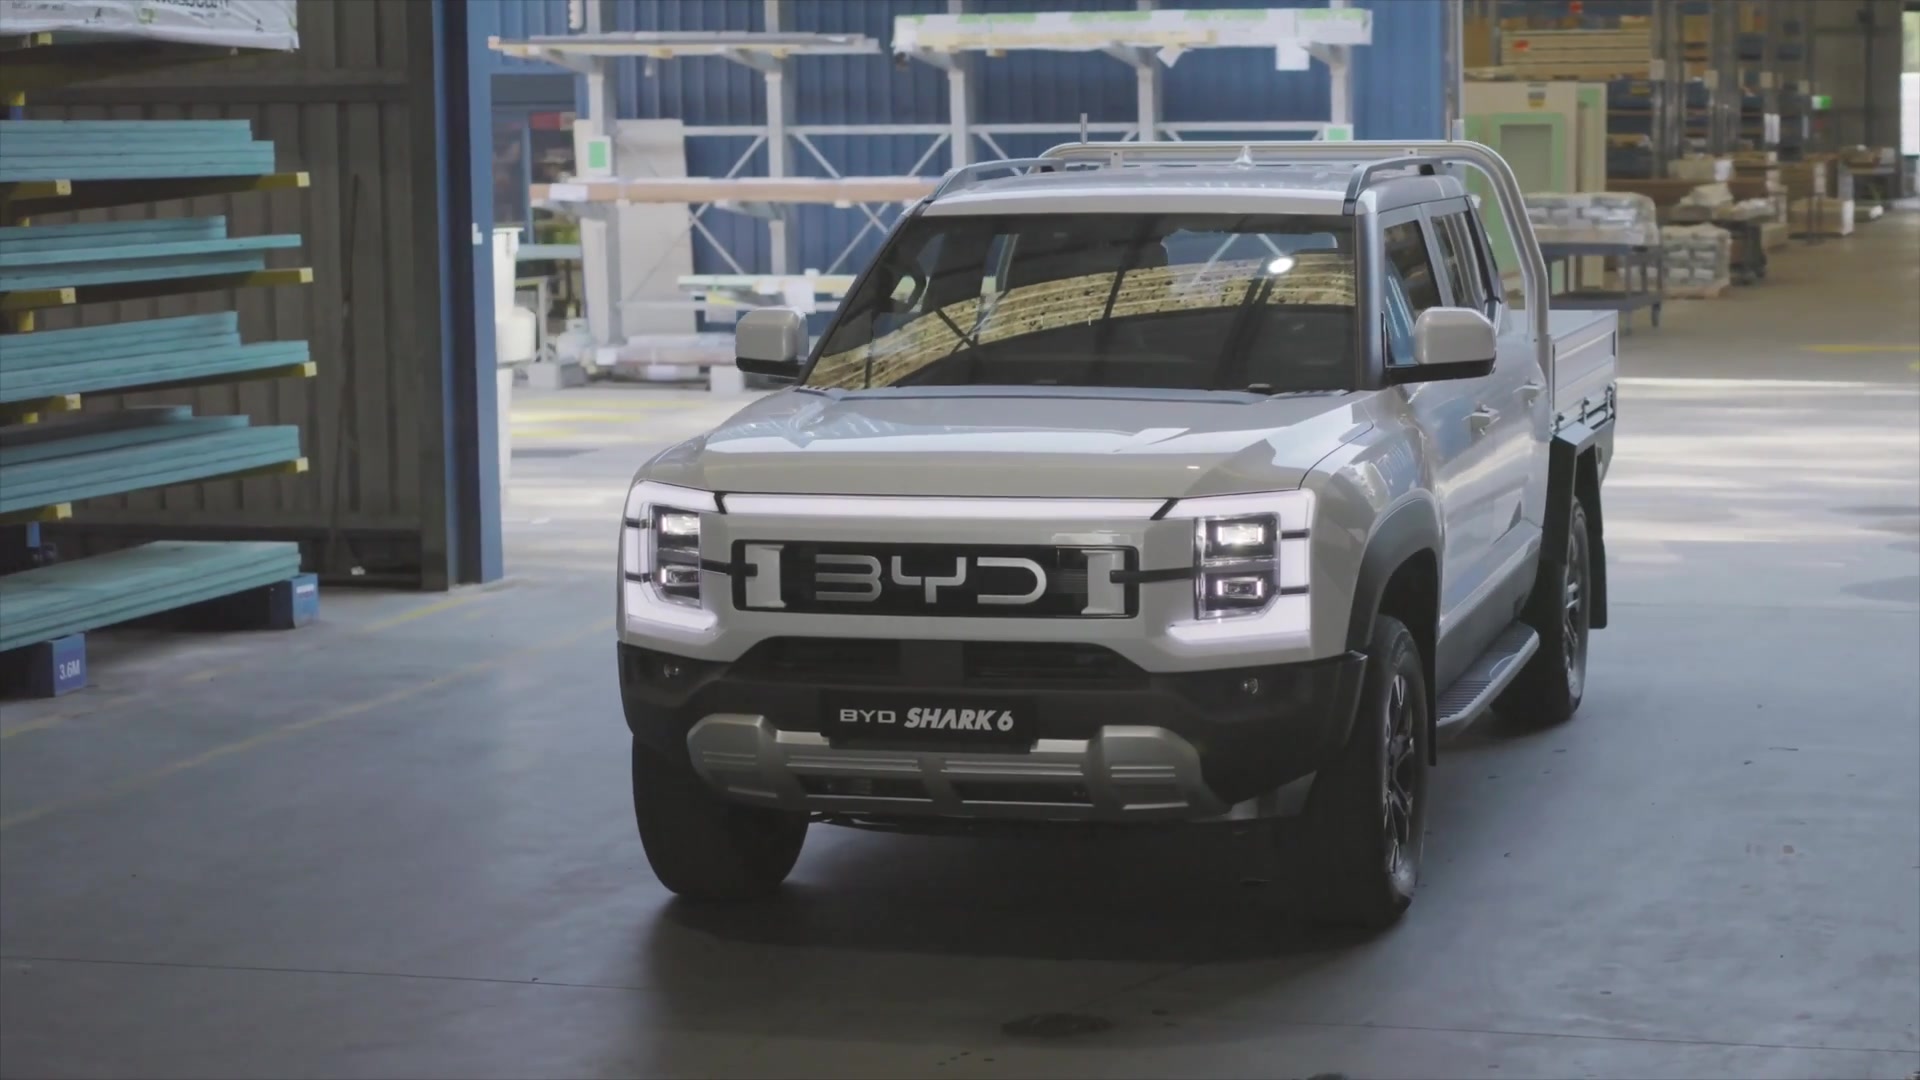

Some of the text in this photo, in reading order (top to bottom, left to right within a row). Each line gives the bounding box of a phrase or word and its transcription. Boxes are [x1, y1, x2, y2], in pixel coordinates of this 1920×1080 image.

[815, 553, 1047, 605] BYD
[59, 659, 81, 681] 3.6M
[839, 707, 1014, 732] BYD SHARK 6
